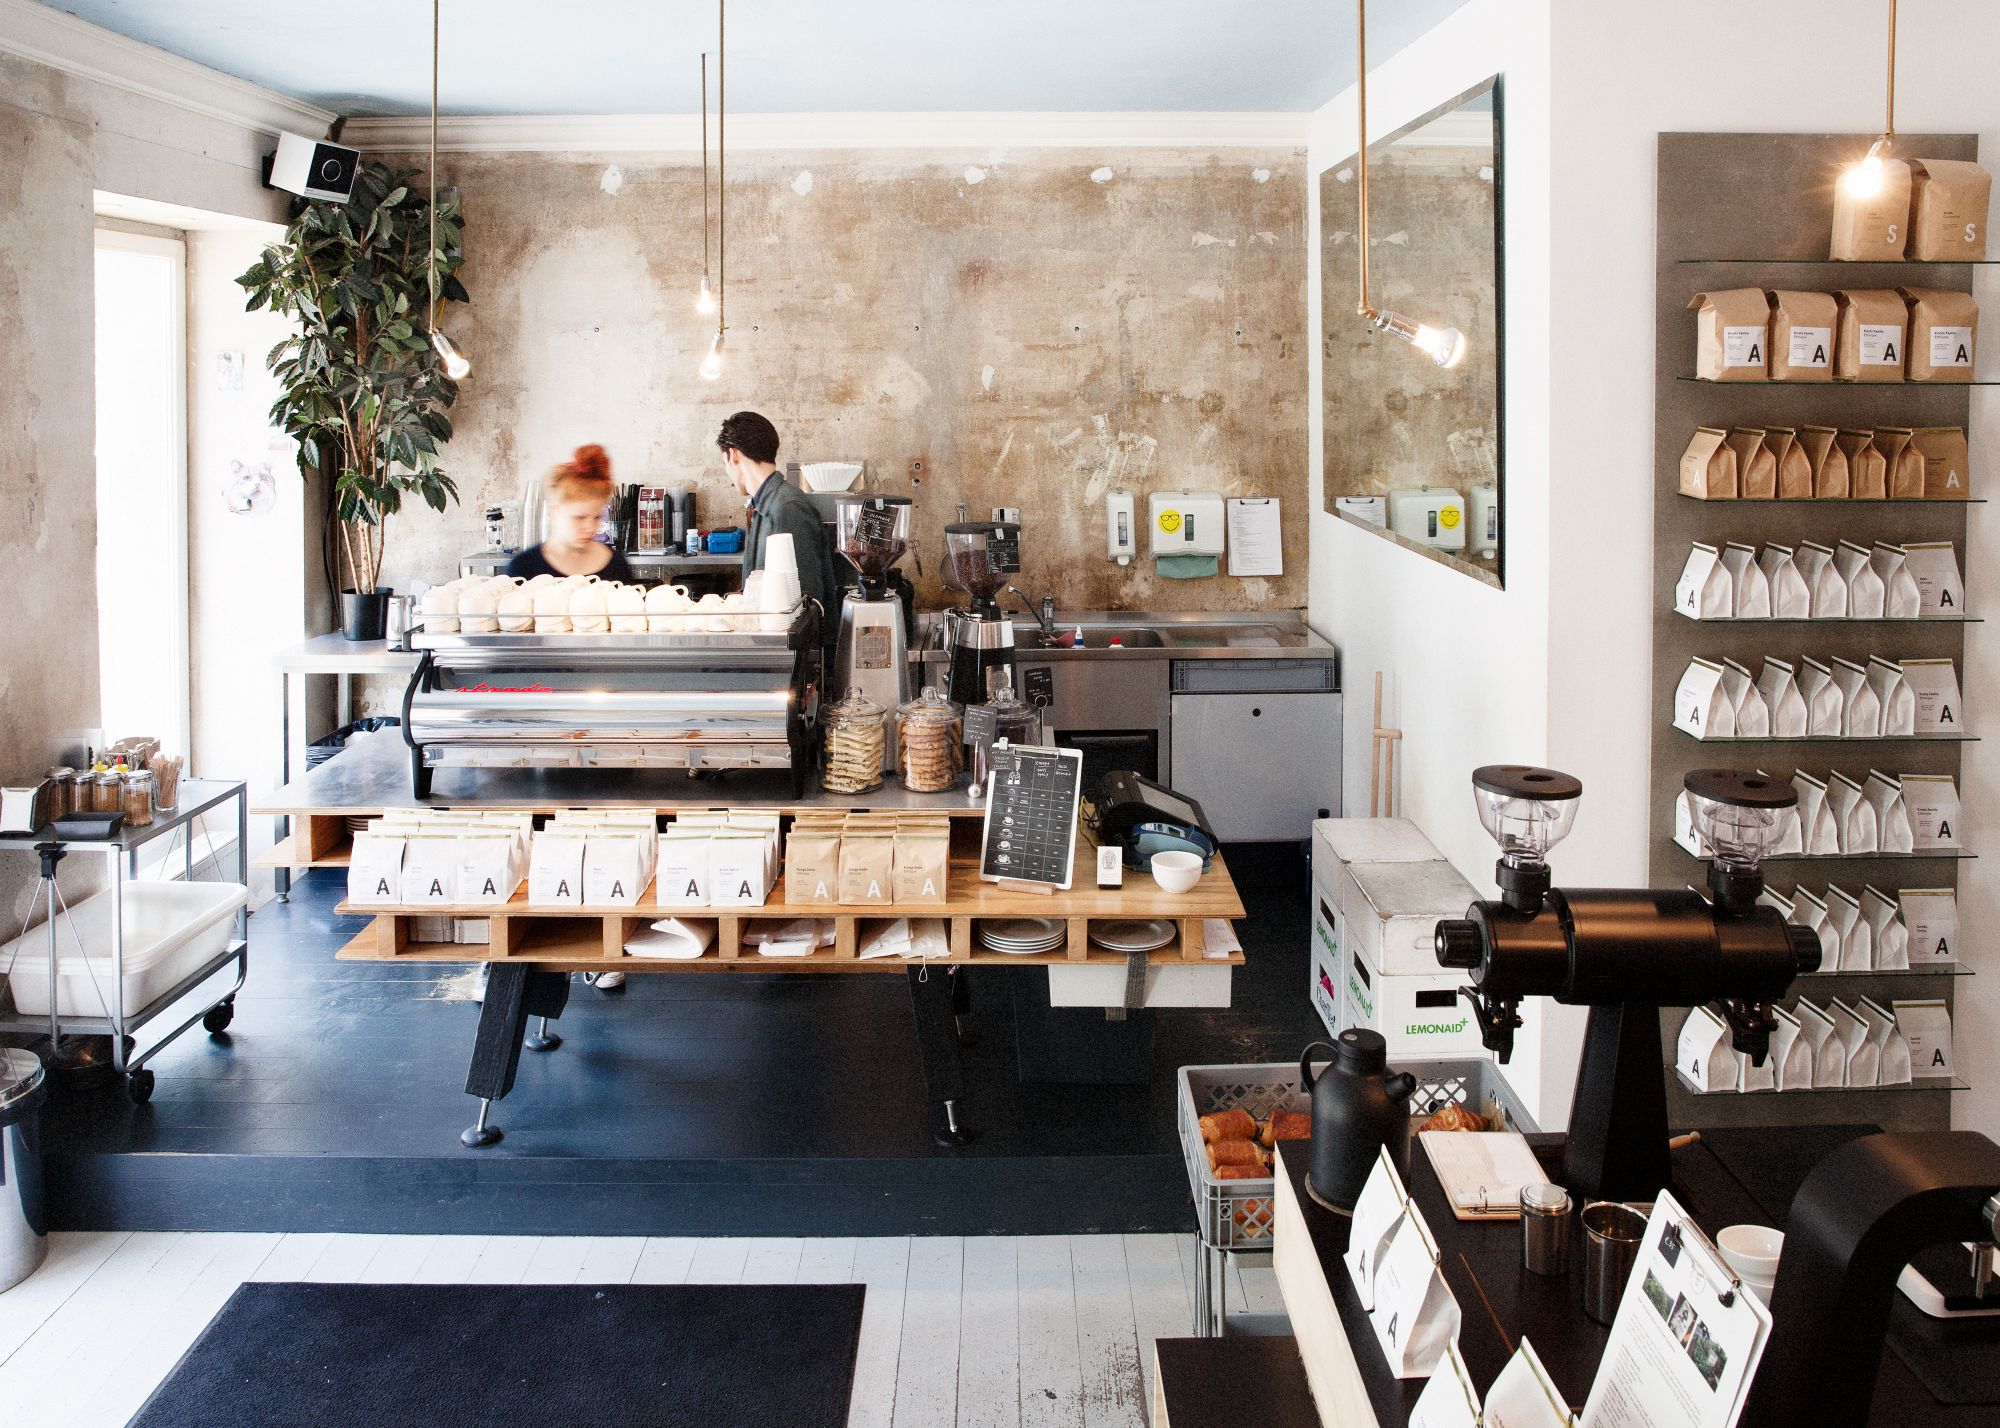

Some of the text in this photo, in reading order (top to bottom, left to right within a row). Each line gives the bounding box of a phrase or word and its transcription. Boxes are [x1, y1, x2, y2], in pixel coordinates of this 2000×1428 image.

[1887, 225, 1897, 243] S
[1964, 223, 1975, 242] S
[1748, 344, 1760, 362] A
[1813, 345, 1825, 363] A
[1883, 343, 1896, 361] A
[1955, 344, 1968, 362] A
[1693, 469, 1701, 489] A
[1946, 470, 1959, 488] A
[1688, 590, 1694, 608] A
[1940, 589, 1953, 607] A
[1690, 707, 1699, 725] A
[1940, 705, 1953, 722] A
[1689, 825, 1696, 843] A
[1938, 821, 1951, 838] A
[377, 878, 390, 894] A
[430, 879, 443, 895] A
[483, 878, 496, 894] A
[557, 880, 570, 896] A
[611, 880, 624, 897] A
[686, 879, 699, 896] A
[738, 881, 752, 897] A
[814, 880, 828, 897] A
[867, 880, 881, 897] A
[922, 878, 936, 895] A
[1935, 938, 1948, 954] A
[1932, 1049, 1945, 1066] A
[1692, 1059, 1699, 1078] A
[1359, 1250, 1365, 1283] A
[1388, 1312, 1397, 1348] A
